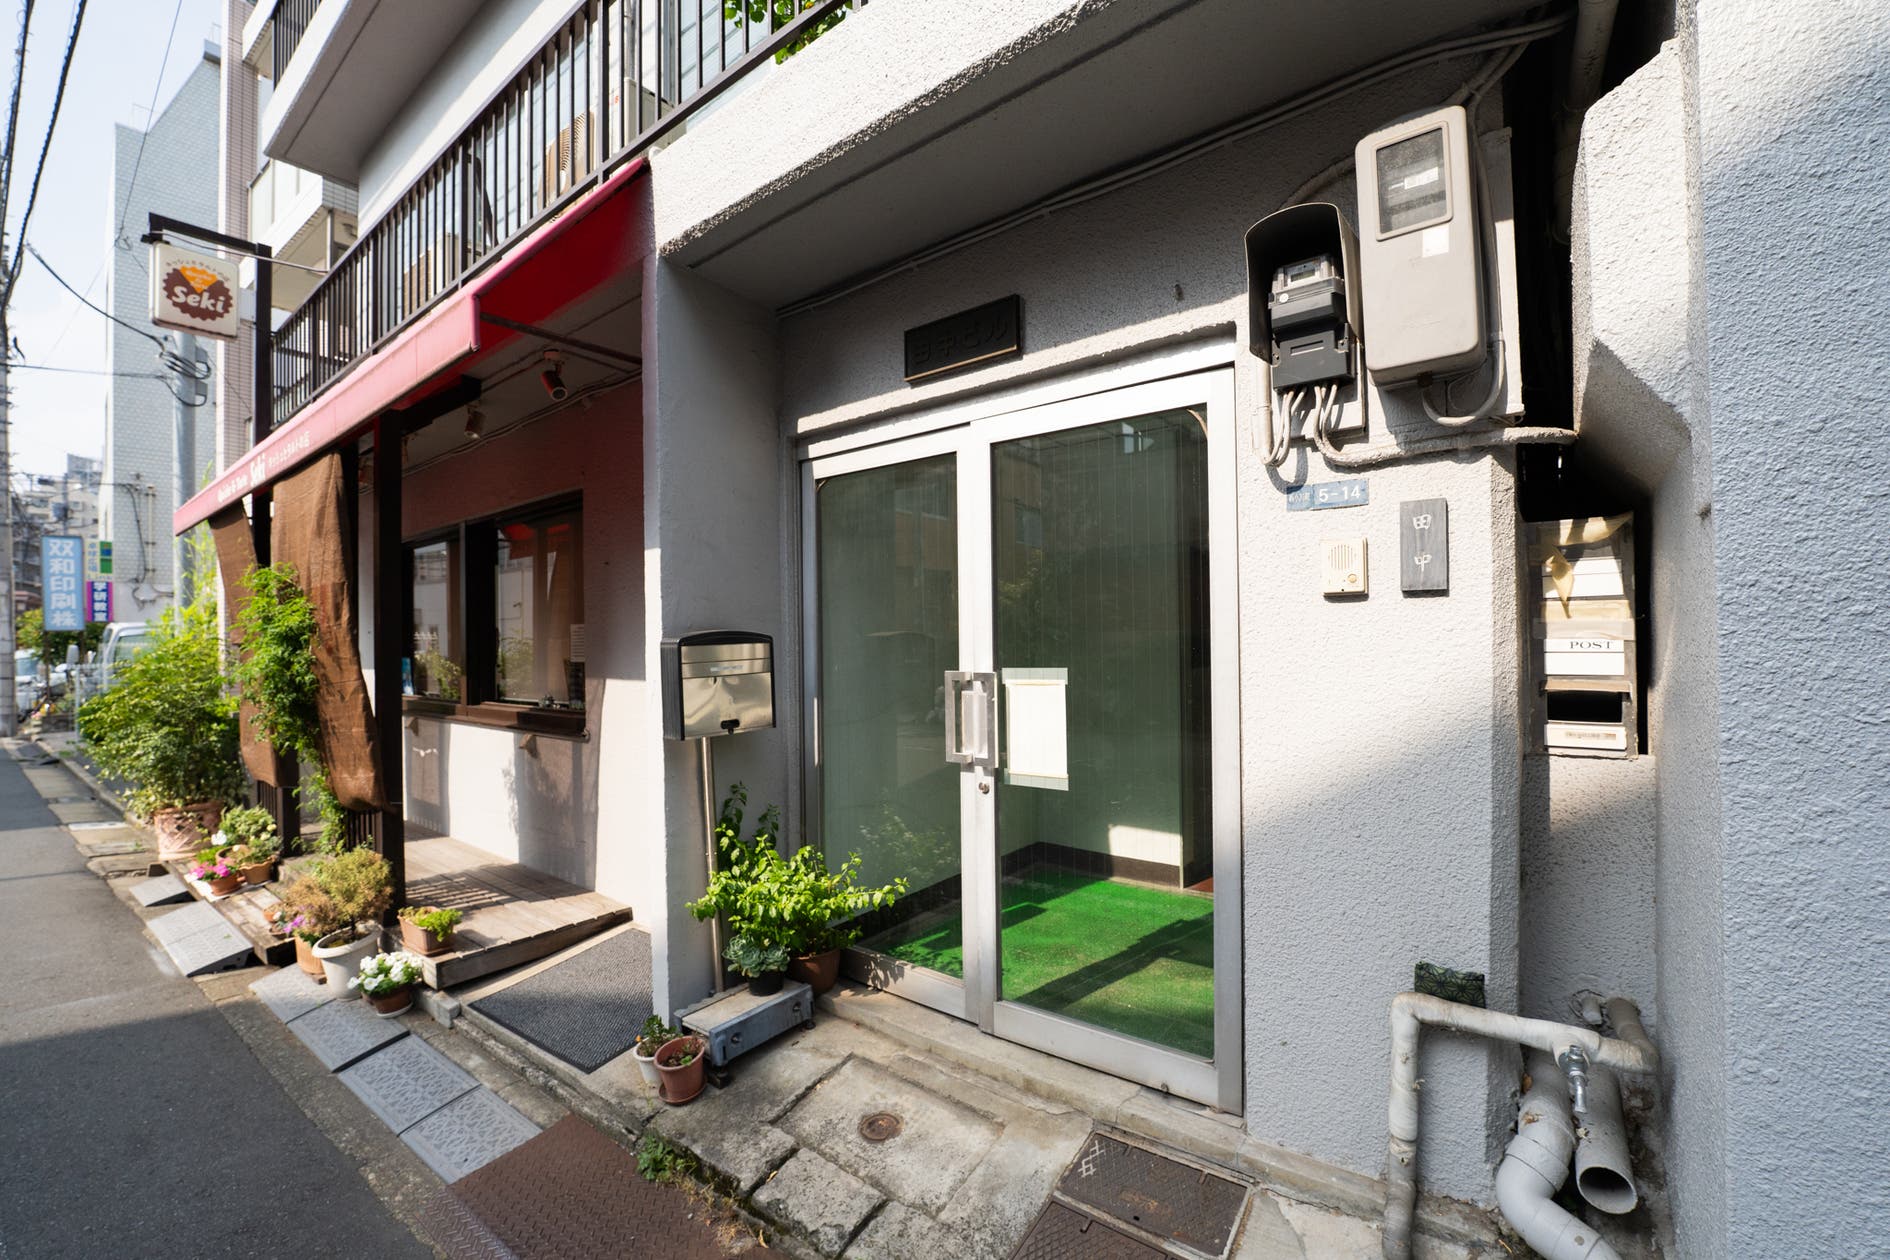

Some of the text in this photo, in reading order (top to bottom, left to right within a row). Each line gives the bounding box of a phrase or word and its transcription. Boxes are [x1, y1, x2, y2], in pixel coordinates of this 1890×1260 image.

[171, 286, 225, 313] Seki
[1319, 485, 1361, 502] 5-14
[1412, 514, 1432, 572] 田中
[1570, 641, 1614, 650] POST
